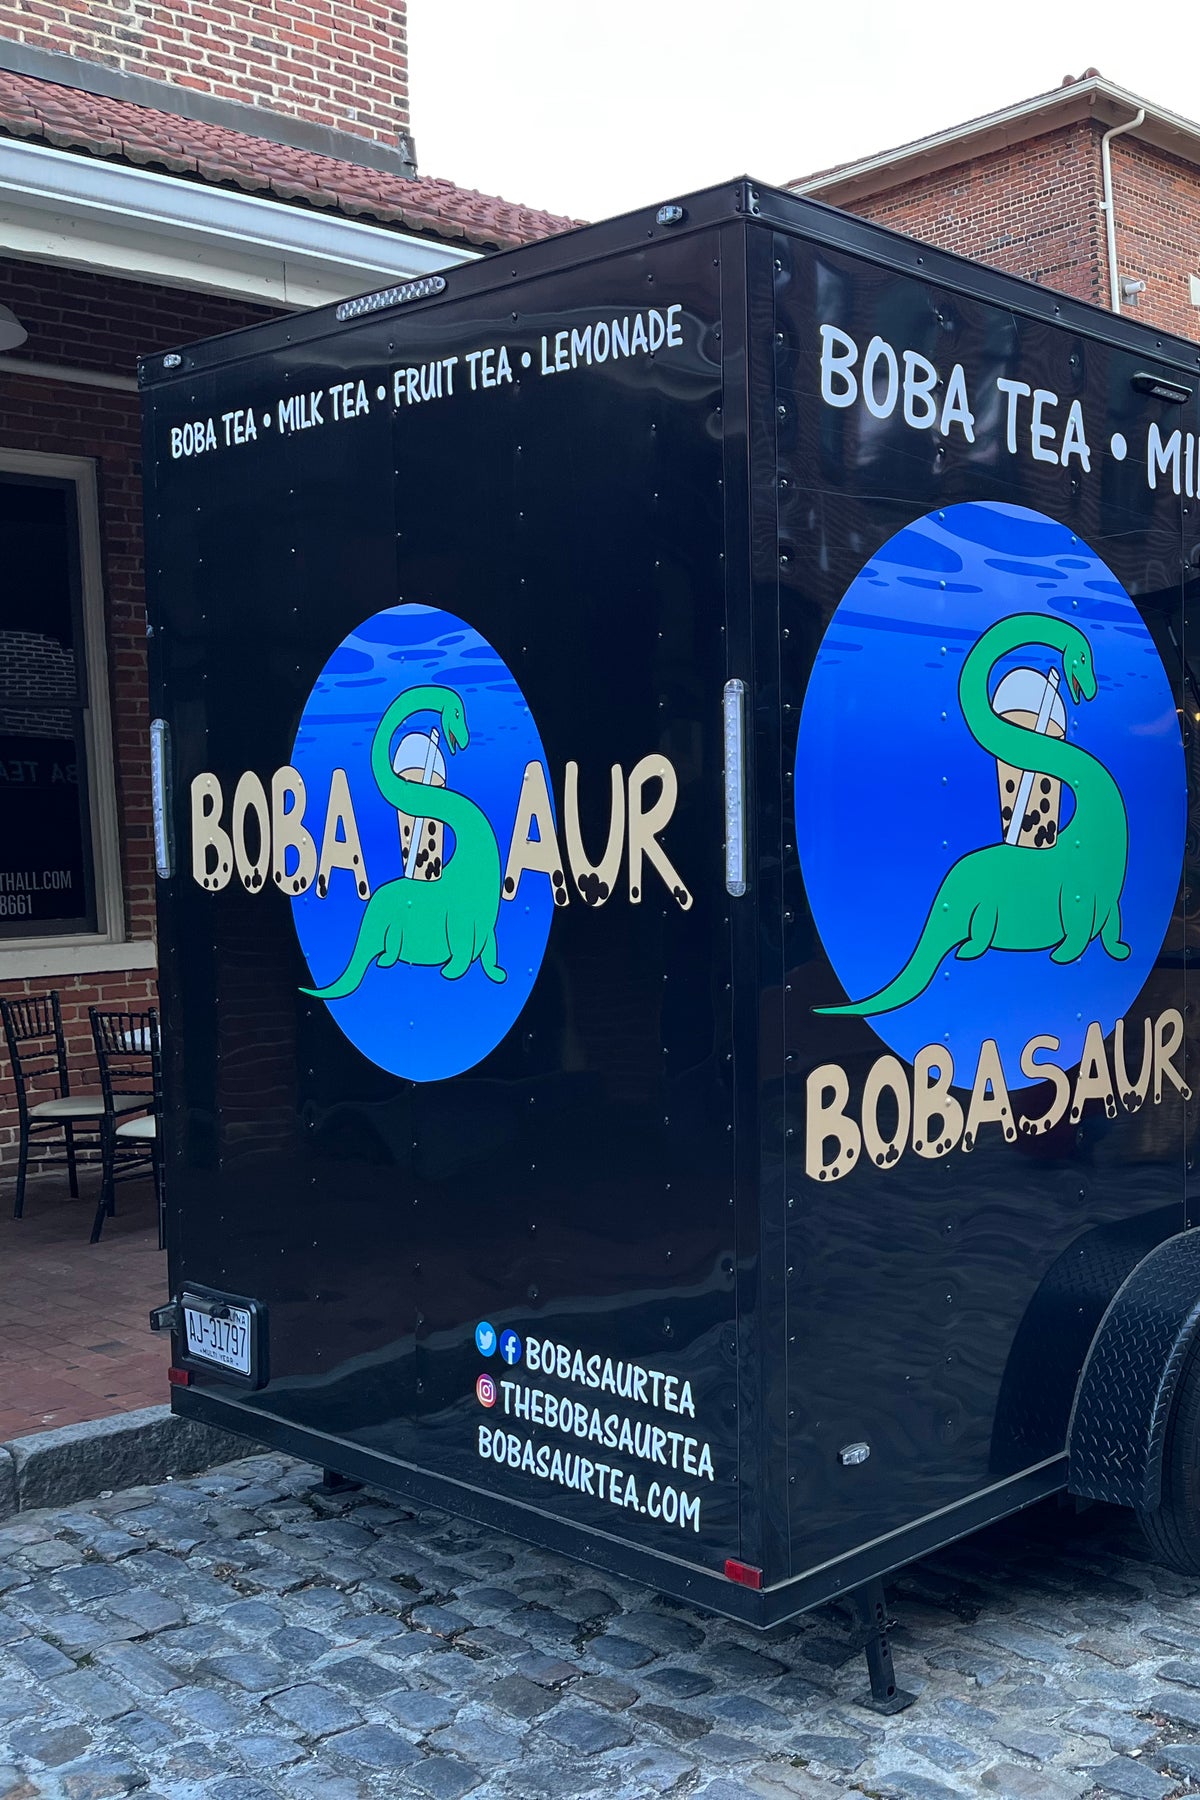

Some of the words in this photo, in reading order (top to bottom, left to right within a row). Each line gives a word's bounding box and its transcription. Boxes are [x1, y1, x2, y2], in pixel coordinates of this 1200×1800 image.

[171, 418, 217, 458] BOBA
[222, 408, 257, 446] TEA
[279, 391, 324, 433] MILK
[329, 380, 369, 420] TEA
[394, 357, 458, 407] FRUIT
[465, 346, 513, 390] TEA
[541, 303, 684, 376] LEMONADE
[819, 324, 976, 443] BOBA
[996, 377, 1091, 473] TEA
[805, 1008, 1193, 1182] BOBASAUR
[189, 1311, 246, 1358] AJ-31797
[525, 1336, 695, 1419] BOBASAURTEA
[478, 1425, 701, 1533] BOBASAURTEA.COM
[500, 1380, 715, 1482] THEBOBASAURTEA
